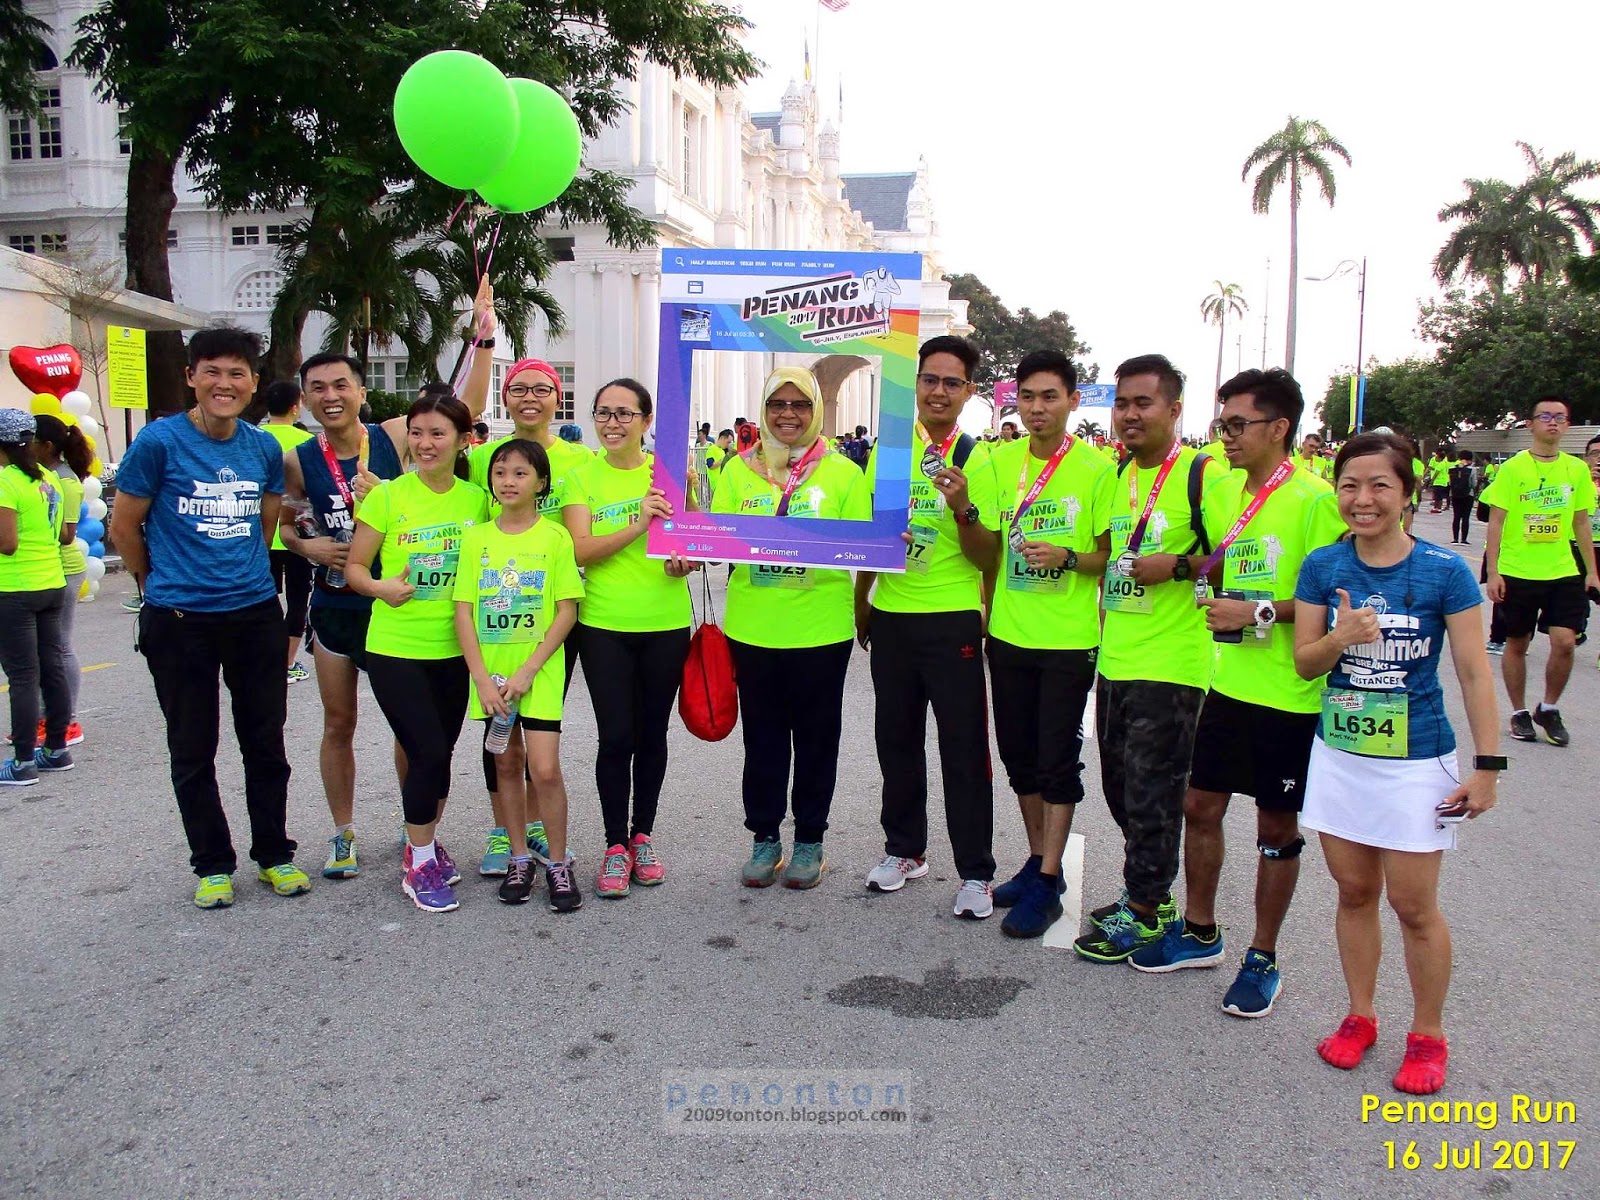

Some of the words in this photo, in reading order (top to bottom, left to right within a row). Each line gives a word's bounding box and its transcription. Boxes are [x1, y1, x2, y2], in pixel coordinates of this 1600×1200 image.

[743, 281, 859, 319] PENANG
[789, 311, 817, 326] 2017
[817, 303, 876, 330] RUN
[35, 353, 72, 366] PENANG
[46, 365, 70, 377] RUN
[1520, 489, 1558, 502] PENANG
[1543, 496, 1563, 505] RUN
[1033, 516, 1066, 531] RUN
[1529, 524, 1558, 534] F390
[210, 526, 247, 537] DISTANCES
[398, 527, 462, 546] PENANG
[697, 543, 713, 552] Like
[760, 547, 799, 556] Comment
[844, 551, 867, 561] Share
[1239, 559, 1266, 575] RUN
[1107, 580, 1145, 598] L405
[486, 613, 535, 629] L073
[1354, 657, 1389, 671] BREAKS
[1351, 674, 1400, 686] DISTANCES
[1333, 712, 1395, 738] L634
